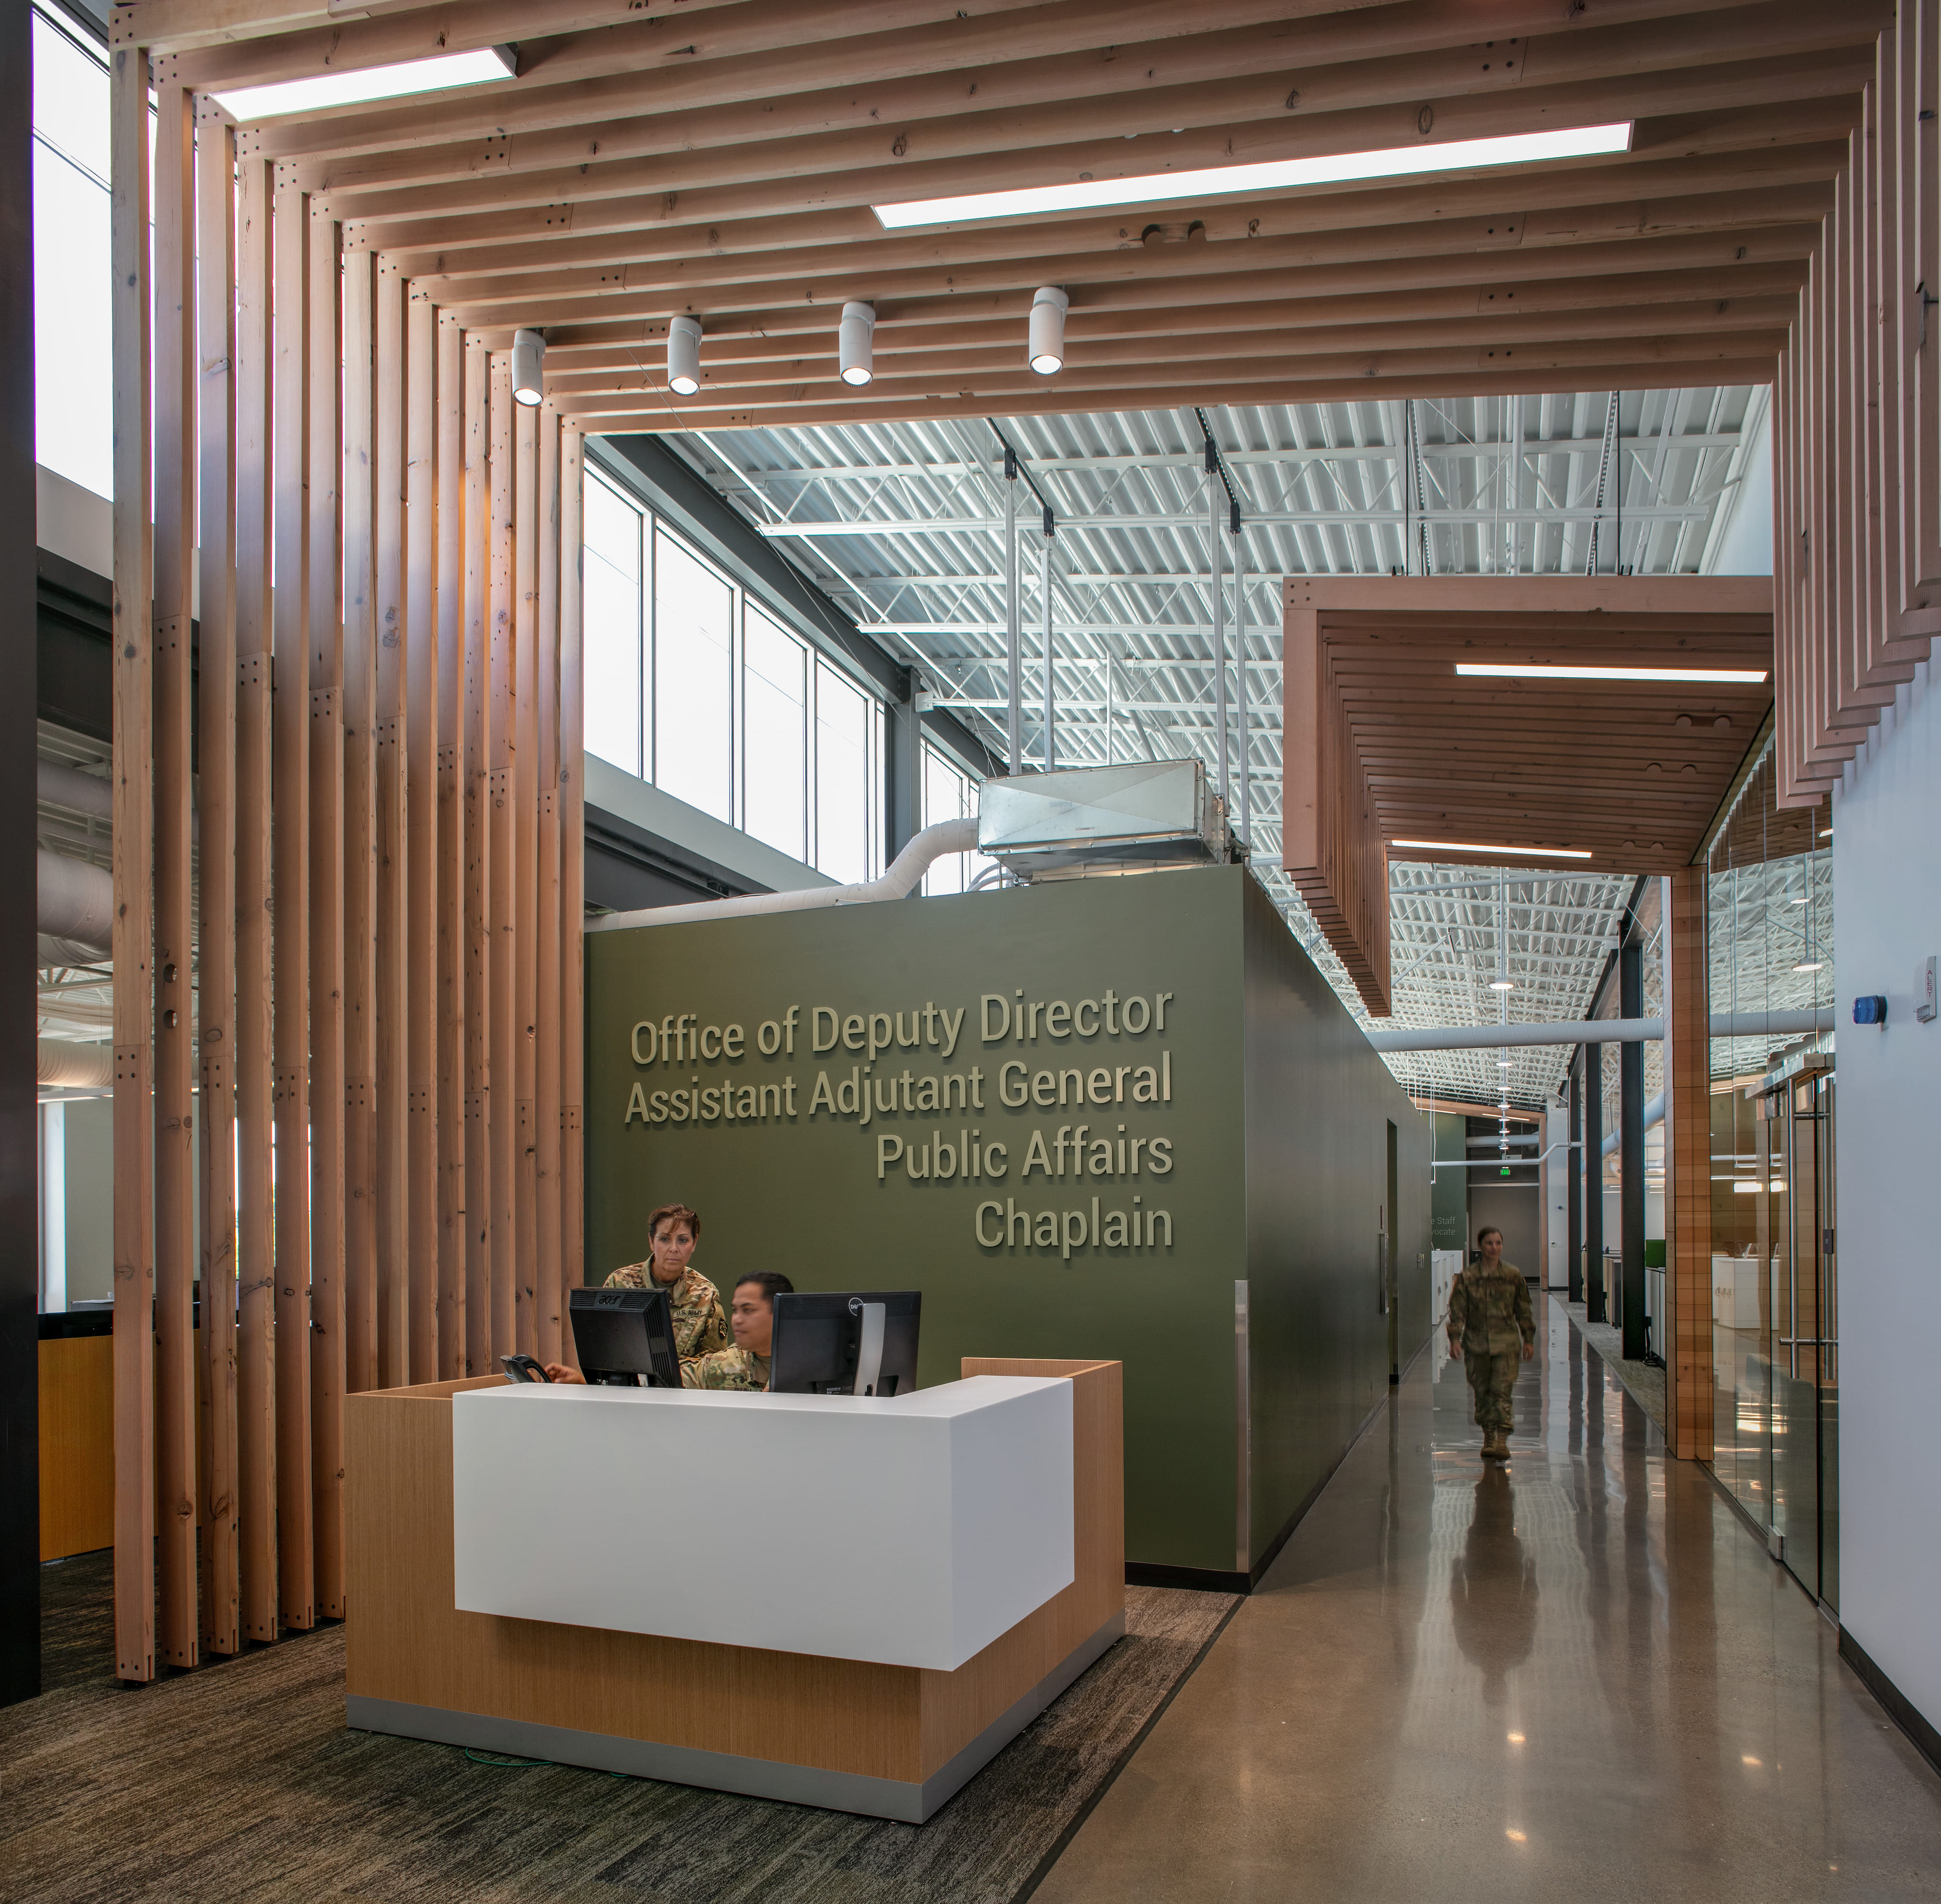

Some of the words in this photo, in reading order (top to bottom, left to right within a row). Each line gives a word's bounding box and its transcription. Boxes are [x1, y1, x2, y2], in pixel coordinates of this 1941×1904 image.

[631, 1014, 744, 1064] Office
[757, 1005, 799, 1055] of
[812, 1002, 964, 1060] Deputy
[981, 989, 1172, 1041] Director
[625, 1076, 797, 1123] Assistant
[808, 1066, 984, 1125] Adjutant
[999, 1051, 1170, 1107] General
[877, 1129, 1007, 1178] Public
[1021, 1125, 1172, 1176] Affairs
[975, 1196, 1172, 1259] Chaplain
[1437, 1216, 1456, 1225] Staff
[598, 1295, 621, 1305] acer
